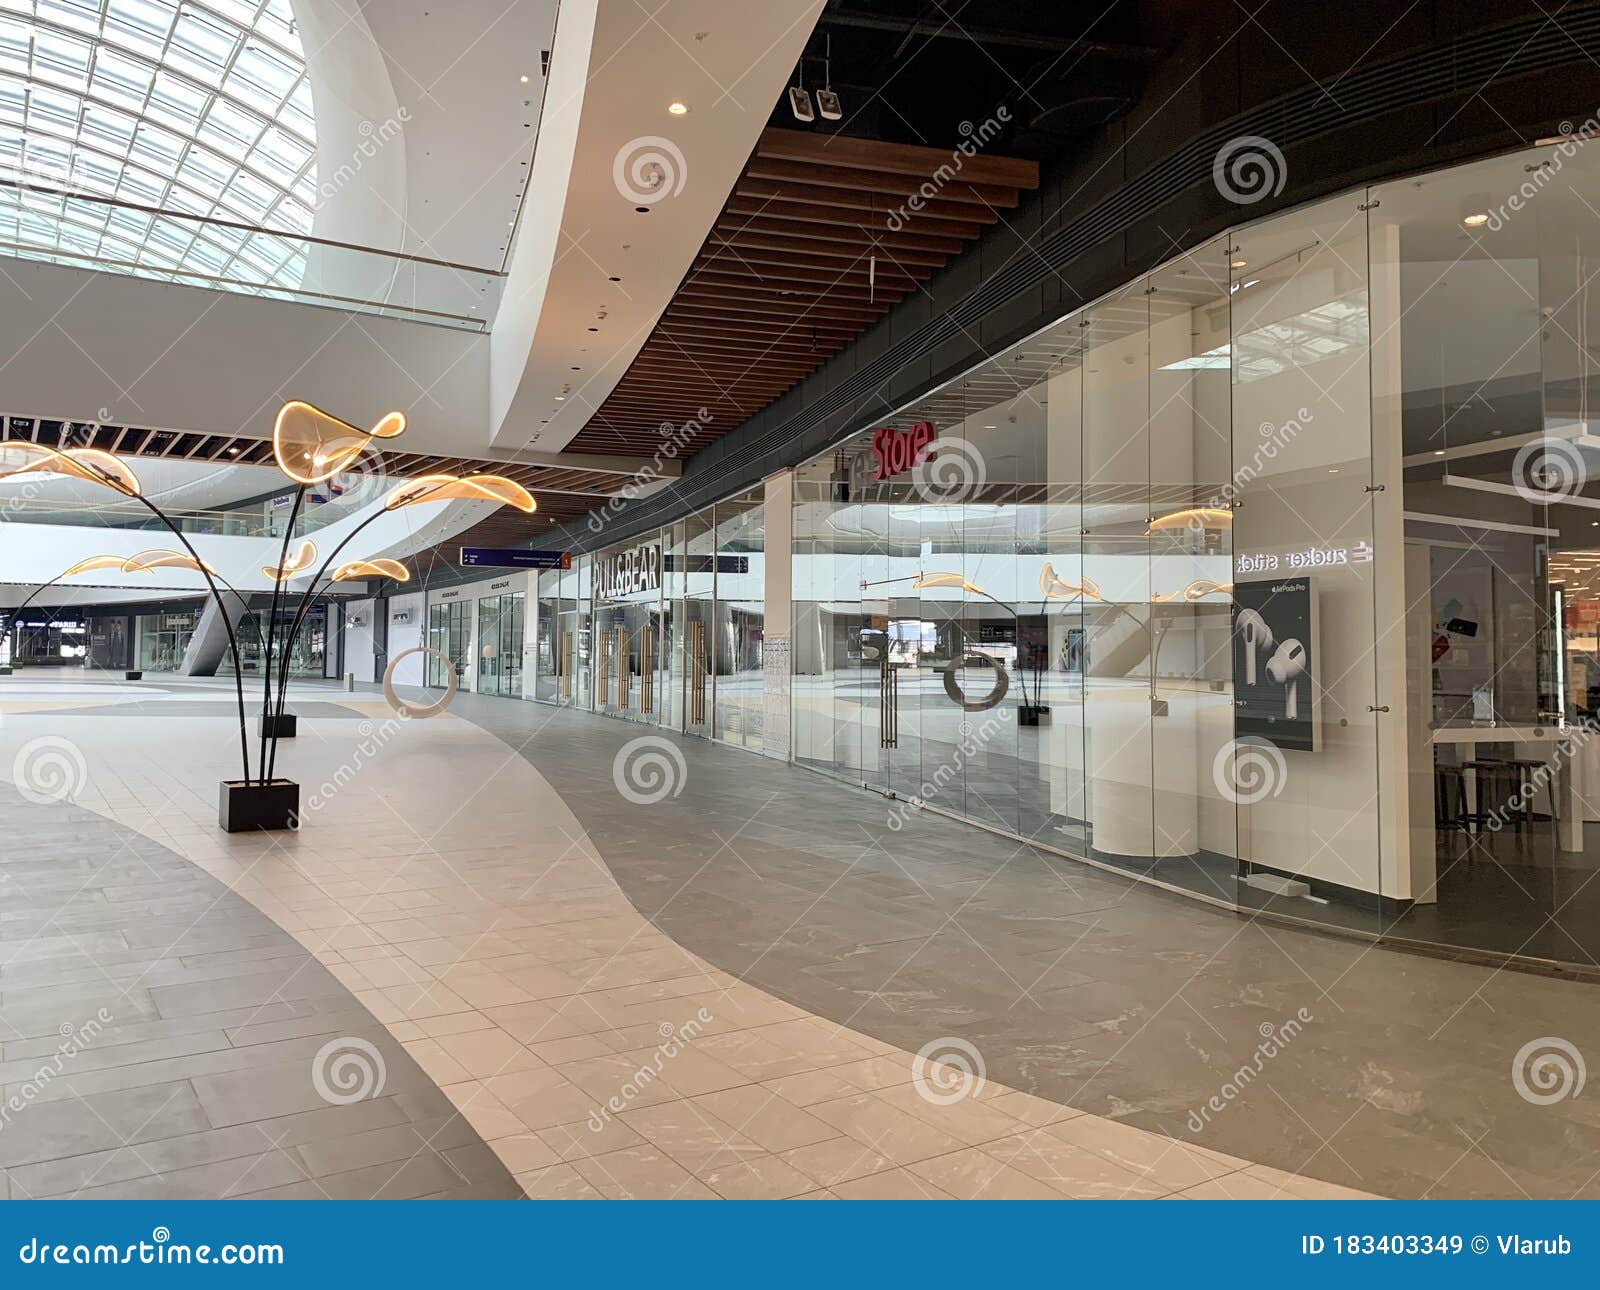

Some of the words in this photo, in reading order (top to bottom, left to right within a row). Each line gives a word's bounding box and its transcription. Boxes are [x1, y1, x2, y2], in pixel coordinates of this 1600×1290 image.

[872, 421, 935, 481] Store
[593, 545, 660, 599] PULL&BEAR
[1296, 583, 1306, 591] Pro
